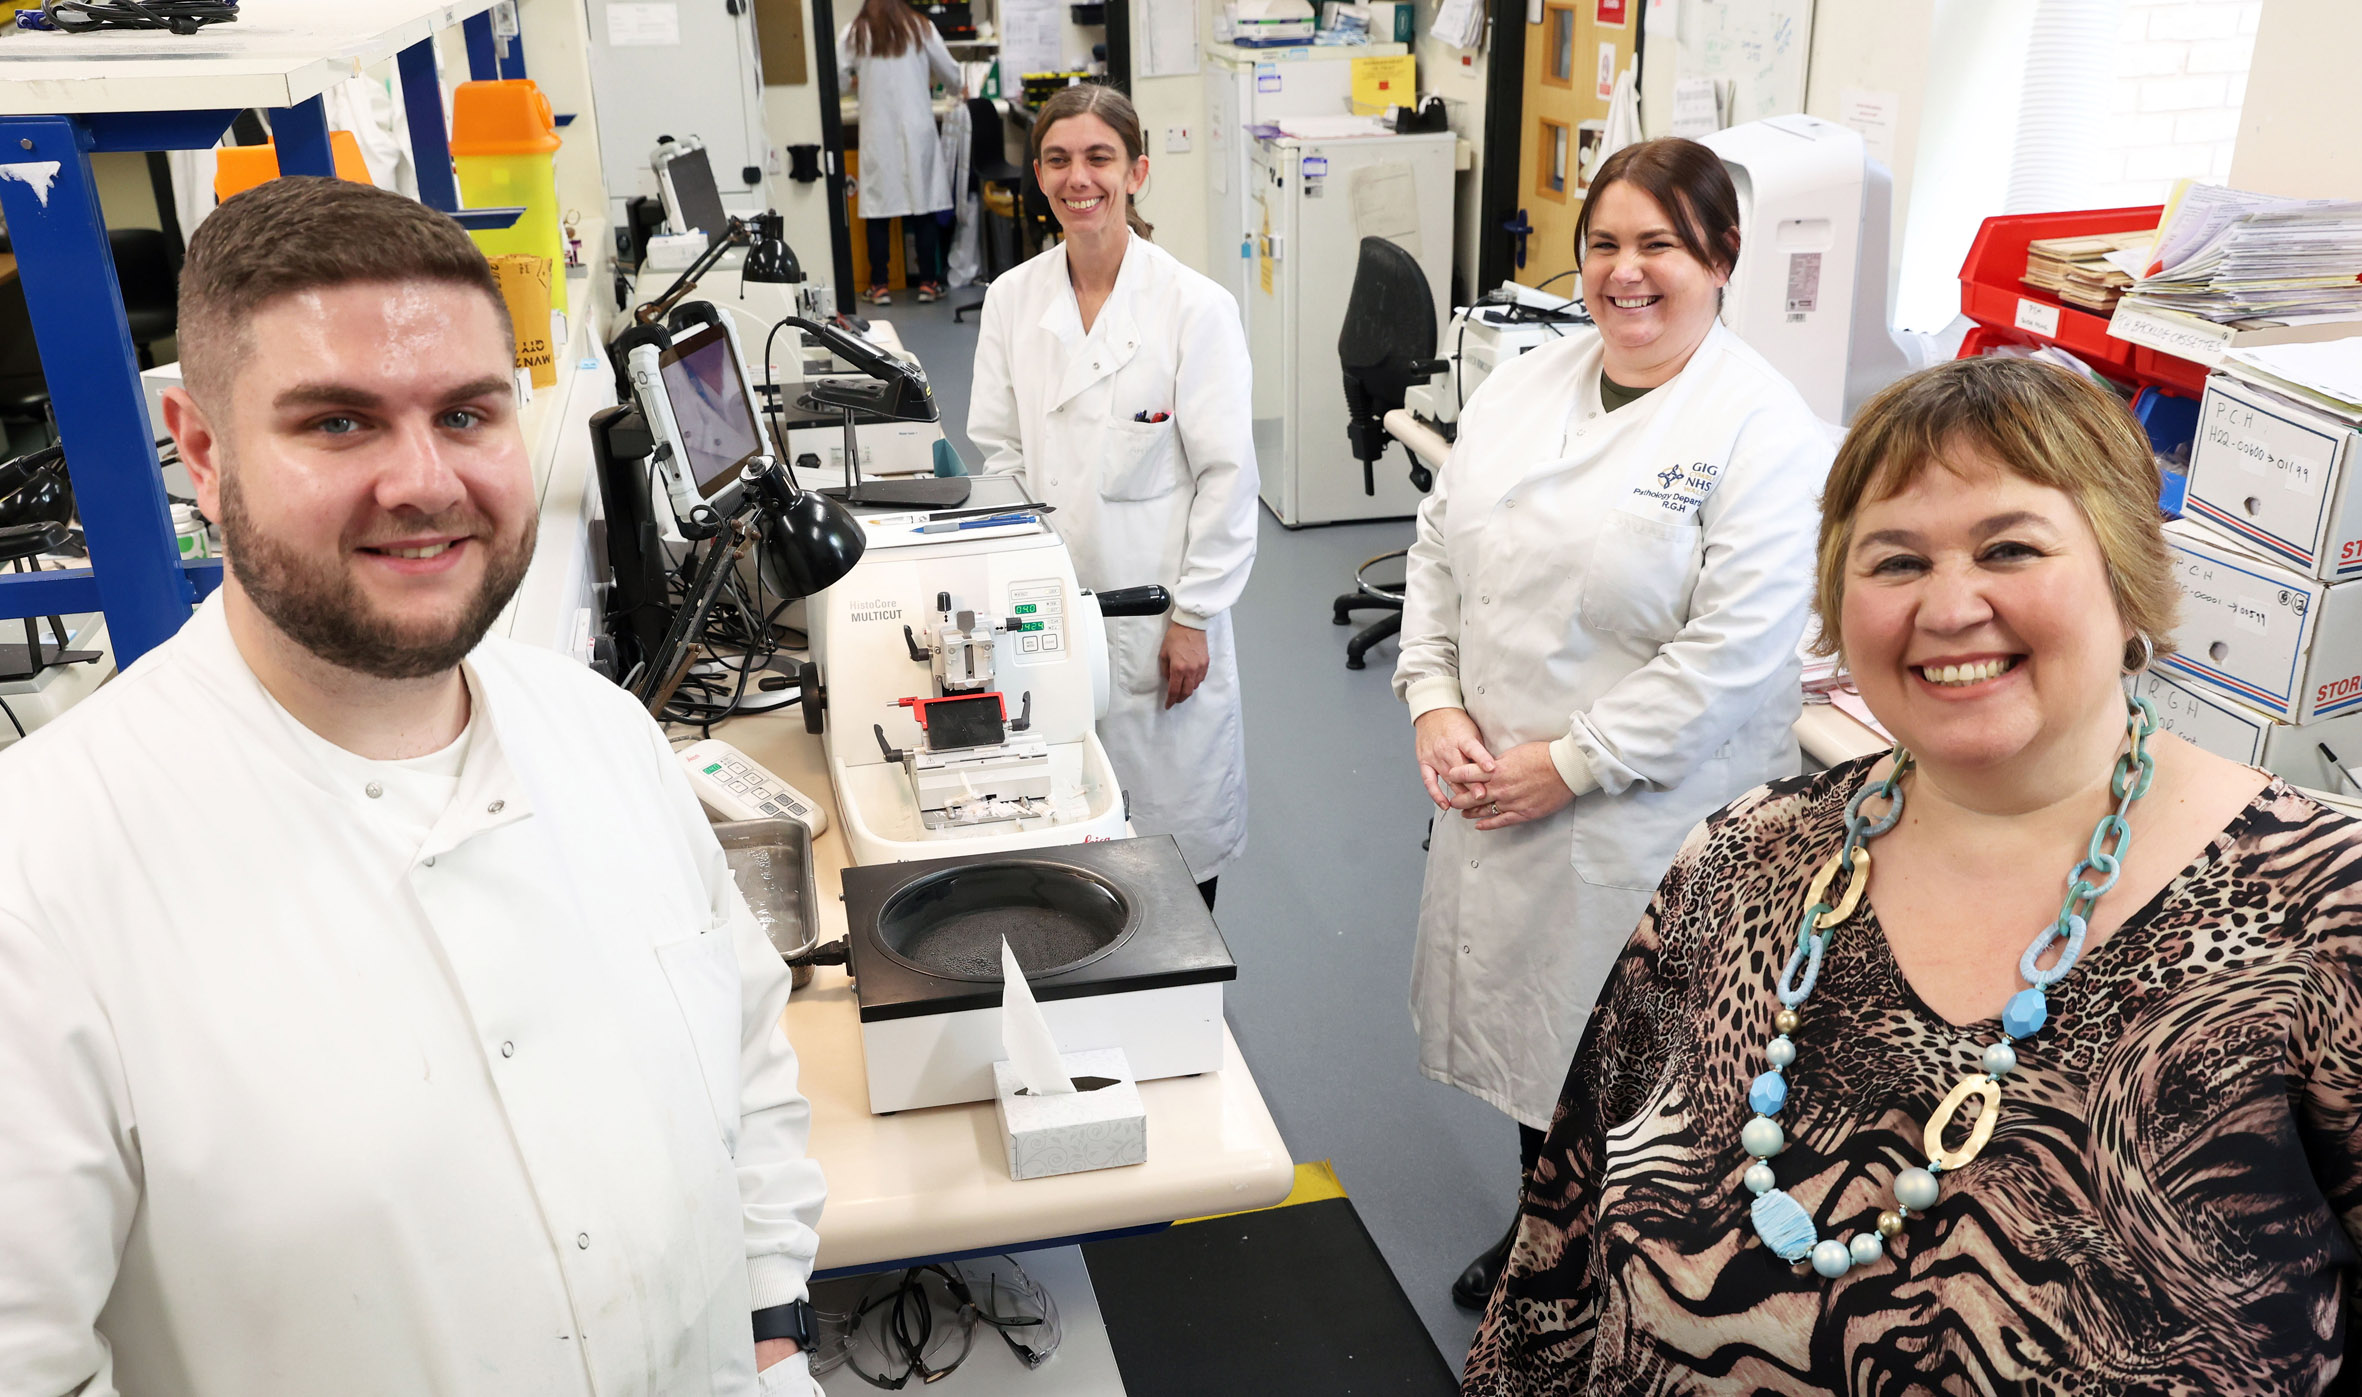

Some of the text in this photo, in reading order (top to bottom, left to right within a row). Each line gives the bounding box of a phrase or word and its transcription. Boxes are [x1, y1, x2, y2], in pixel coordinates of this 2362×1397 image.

[1692, 462, 1718, 476] GIG
[1685, 477, 1712, 492] NHS
[1633, 487, 1672, 501] Pathology
[1661, 500, 1686, 513] R.G.H
[850, 599, 897, 610] HistoCore
[851, 609, 902, 623] MULTICUT
